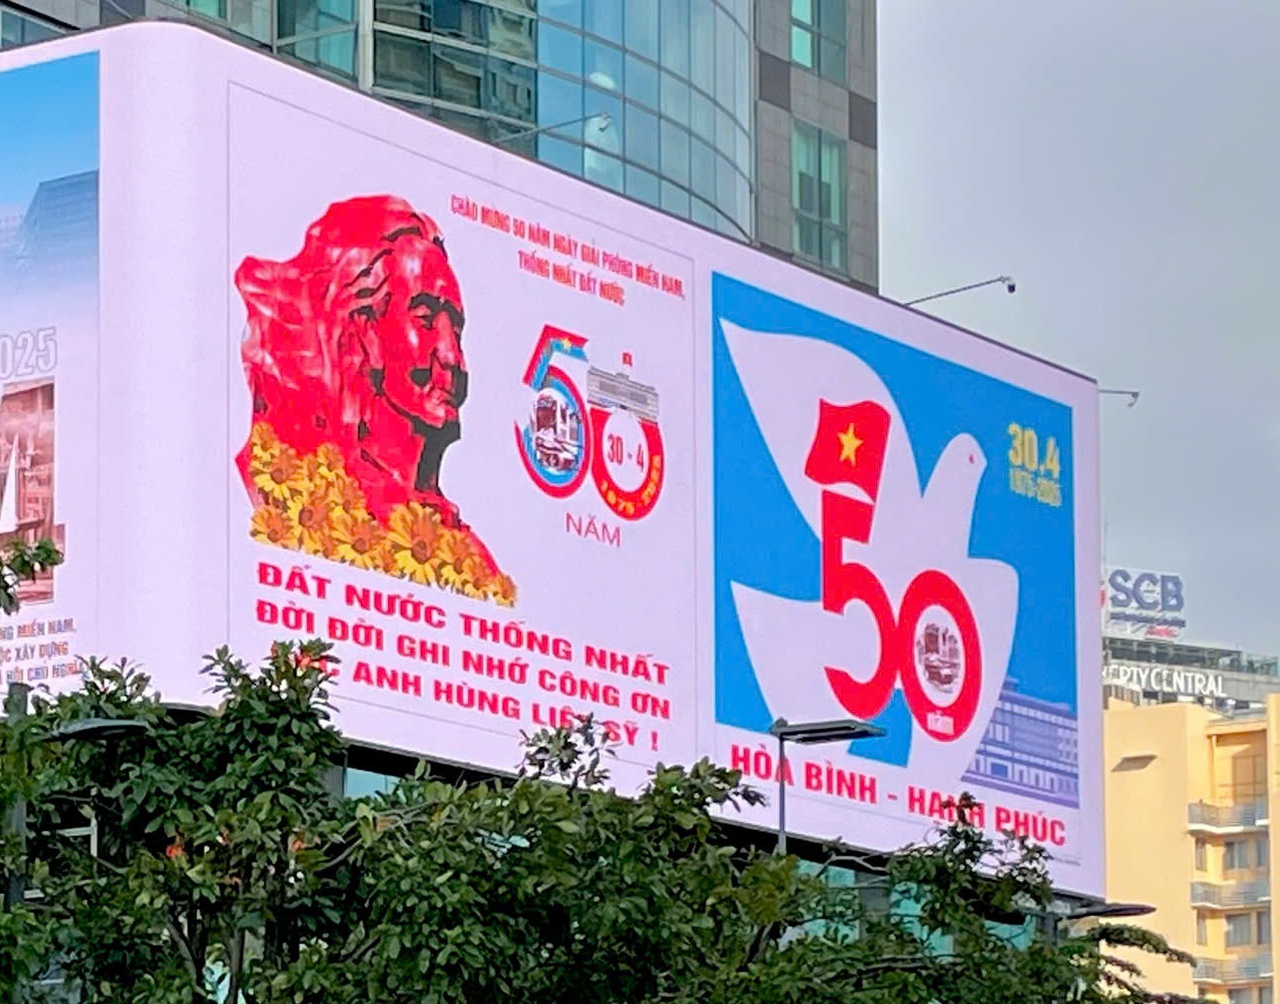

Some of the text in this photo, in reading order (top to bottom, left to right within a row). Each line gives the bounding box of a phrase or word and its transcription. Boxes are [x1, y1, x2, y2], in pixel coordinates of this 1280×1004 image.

[565, 512, 621, 547] NĂM
[257, 562, 670, 686] ĐẤT NƯỚC THỐNG NHẤT
[822, 488, 983, 743] 50
[1109, 569, 1184, 612] SCB
[256, 599, 672, 721] ĐỜI ĐỜI GHI NHỚ CÔNG ƠN
[353, 660, 421, 696] ANH
[434, 678, 521, 721] HÙNG
[1151, 668, 1228, 697] CENTRAL
[731, 743, 794, 786] HÒA
[805, 759, 877, 804] BÌNH
[995, 810, 1066, 846] PHÚC
